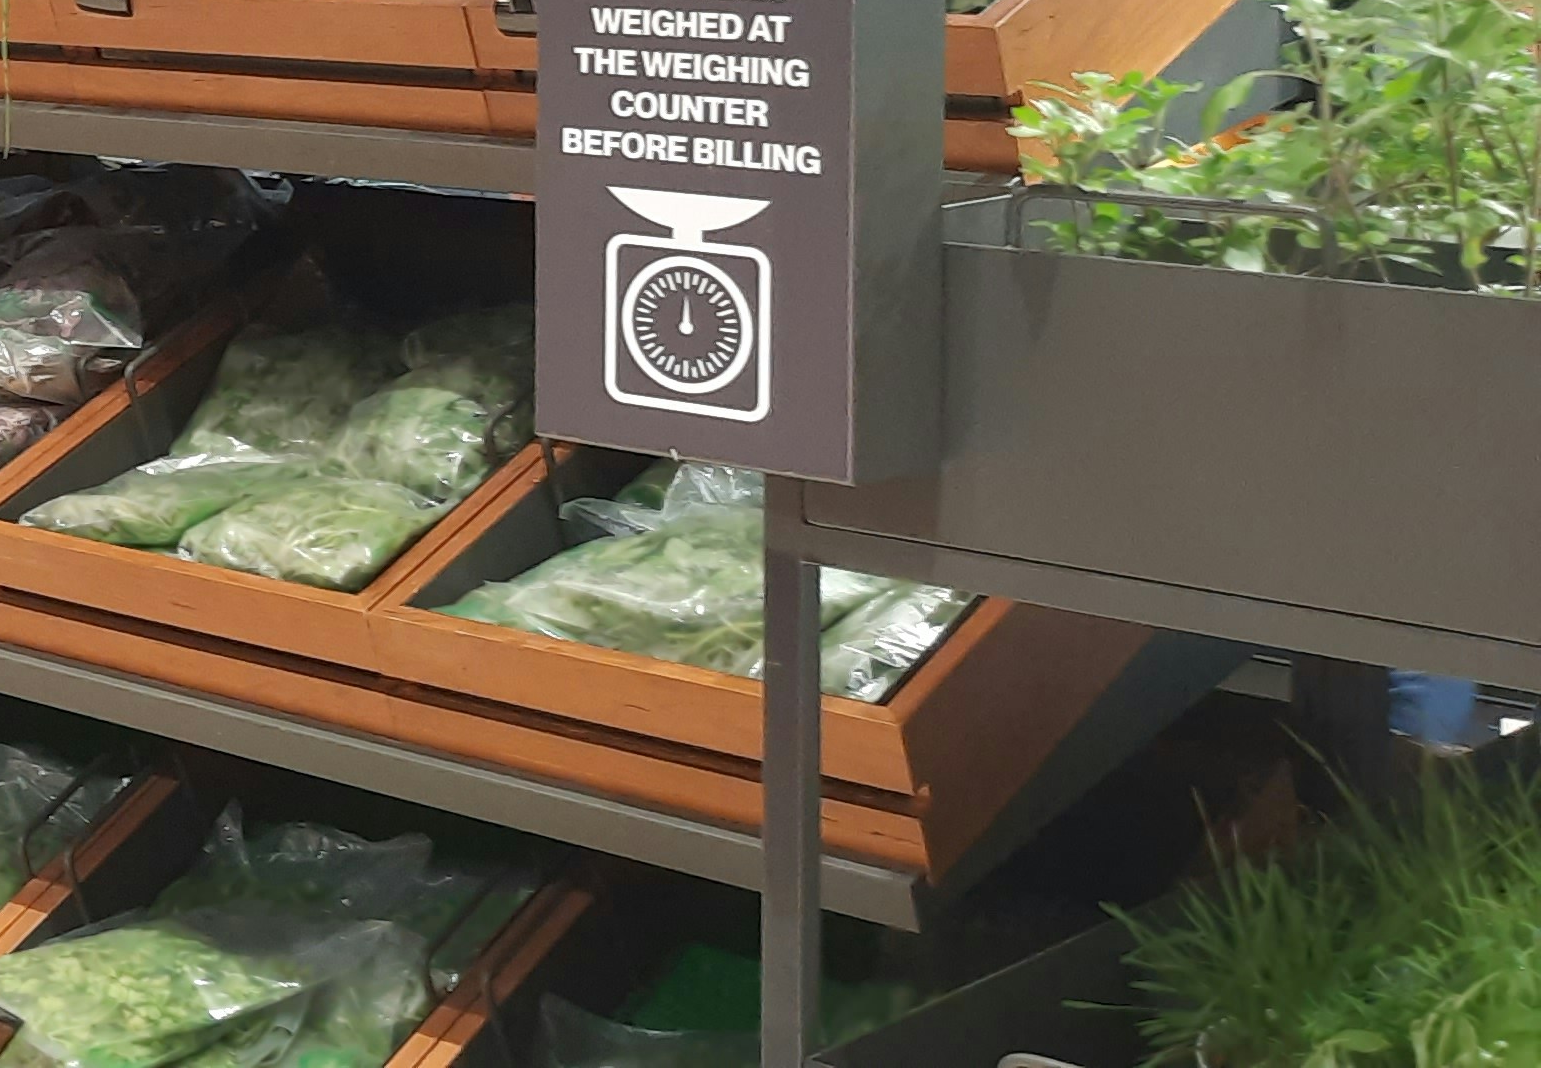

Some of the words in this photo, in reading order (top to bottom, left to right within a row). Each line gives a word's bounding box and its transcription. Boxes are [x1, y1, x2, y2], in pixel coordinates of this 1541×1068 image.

[591, 7, 743, 39] WEIGHED
[748, 14, 792, 43] AT
[573, 47, 637, 76] THE
[641, 50, 810, 88] WEIGHING
[611, 90, 769, 128] COUNTER
[562, 127, 689, 163] BEFORE
[693, 137, 822, 175] BILLING
